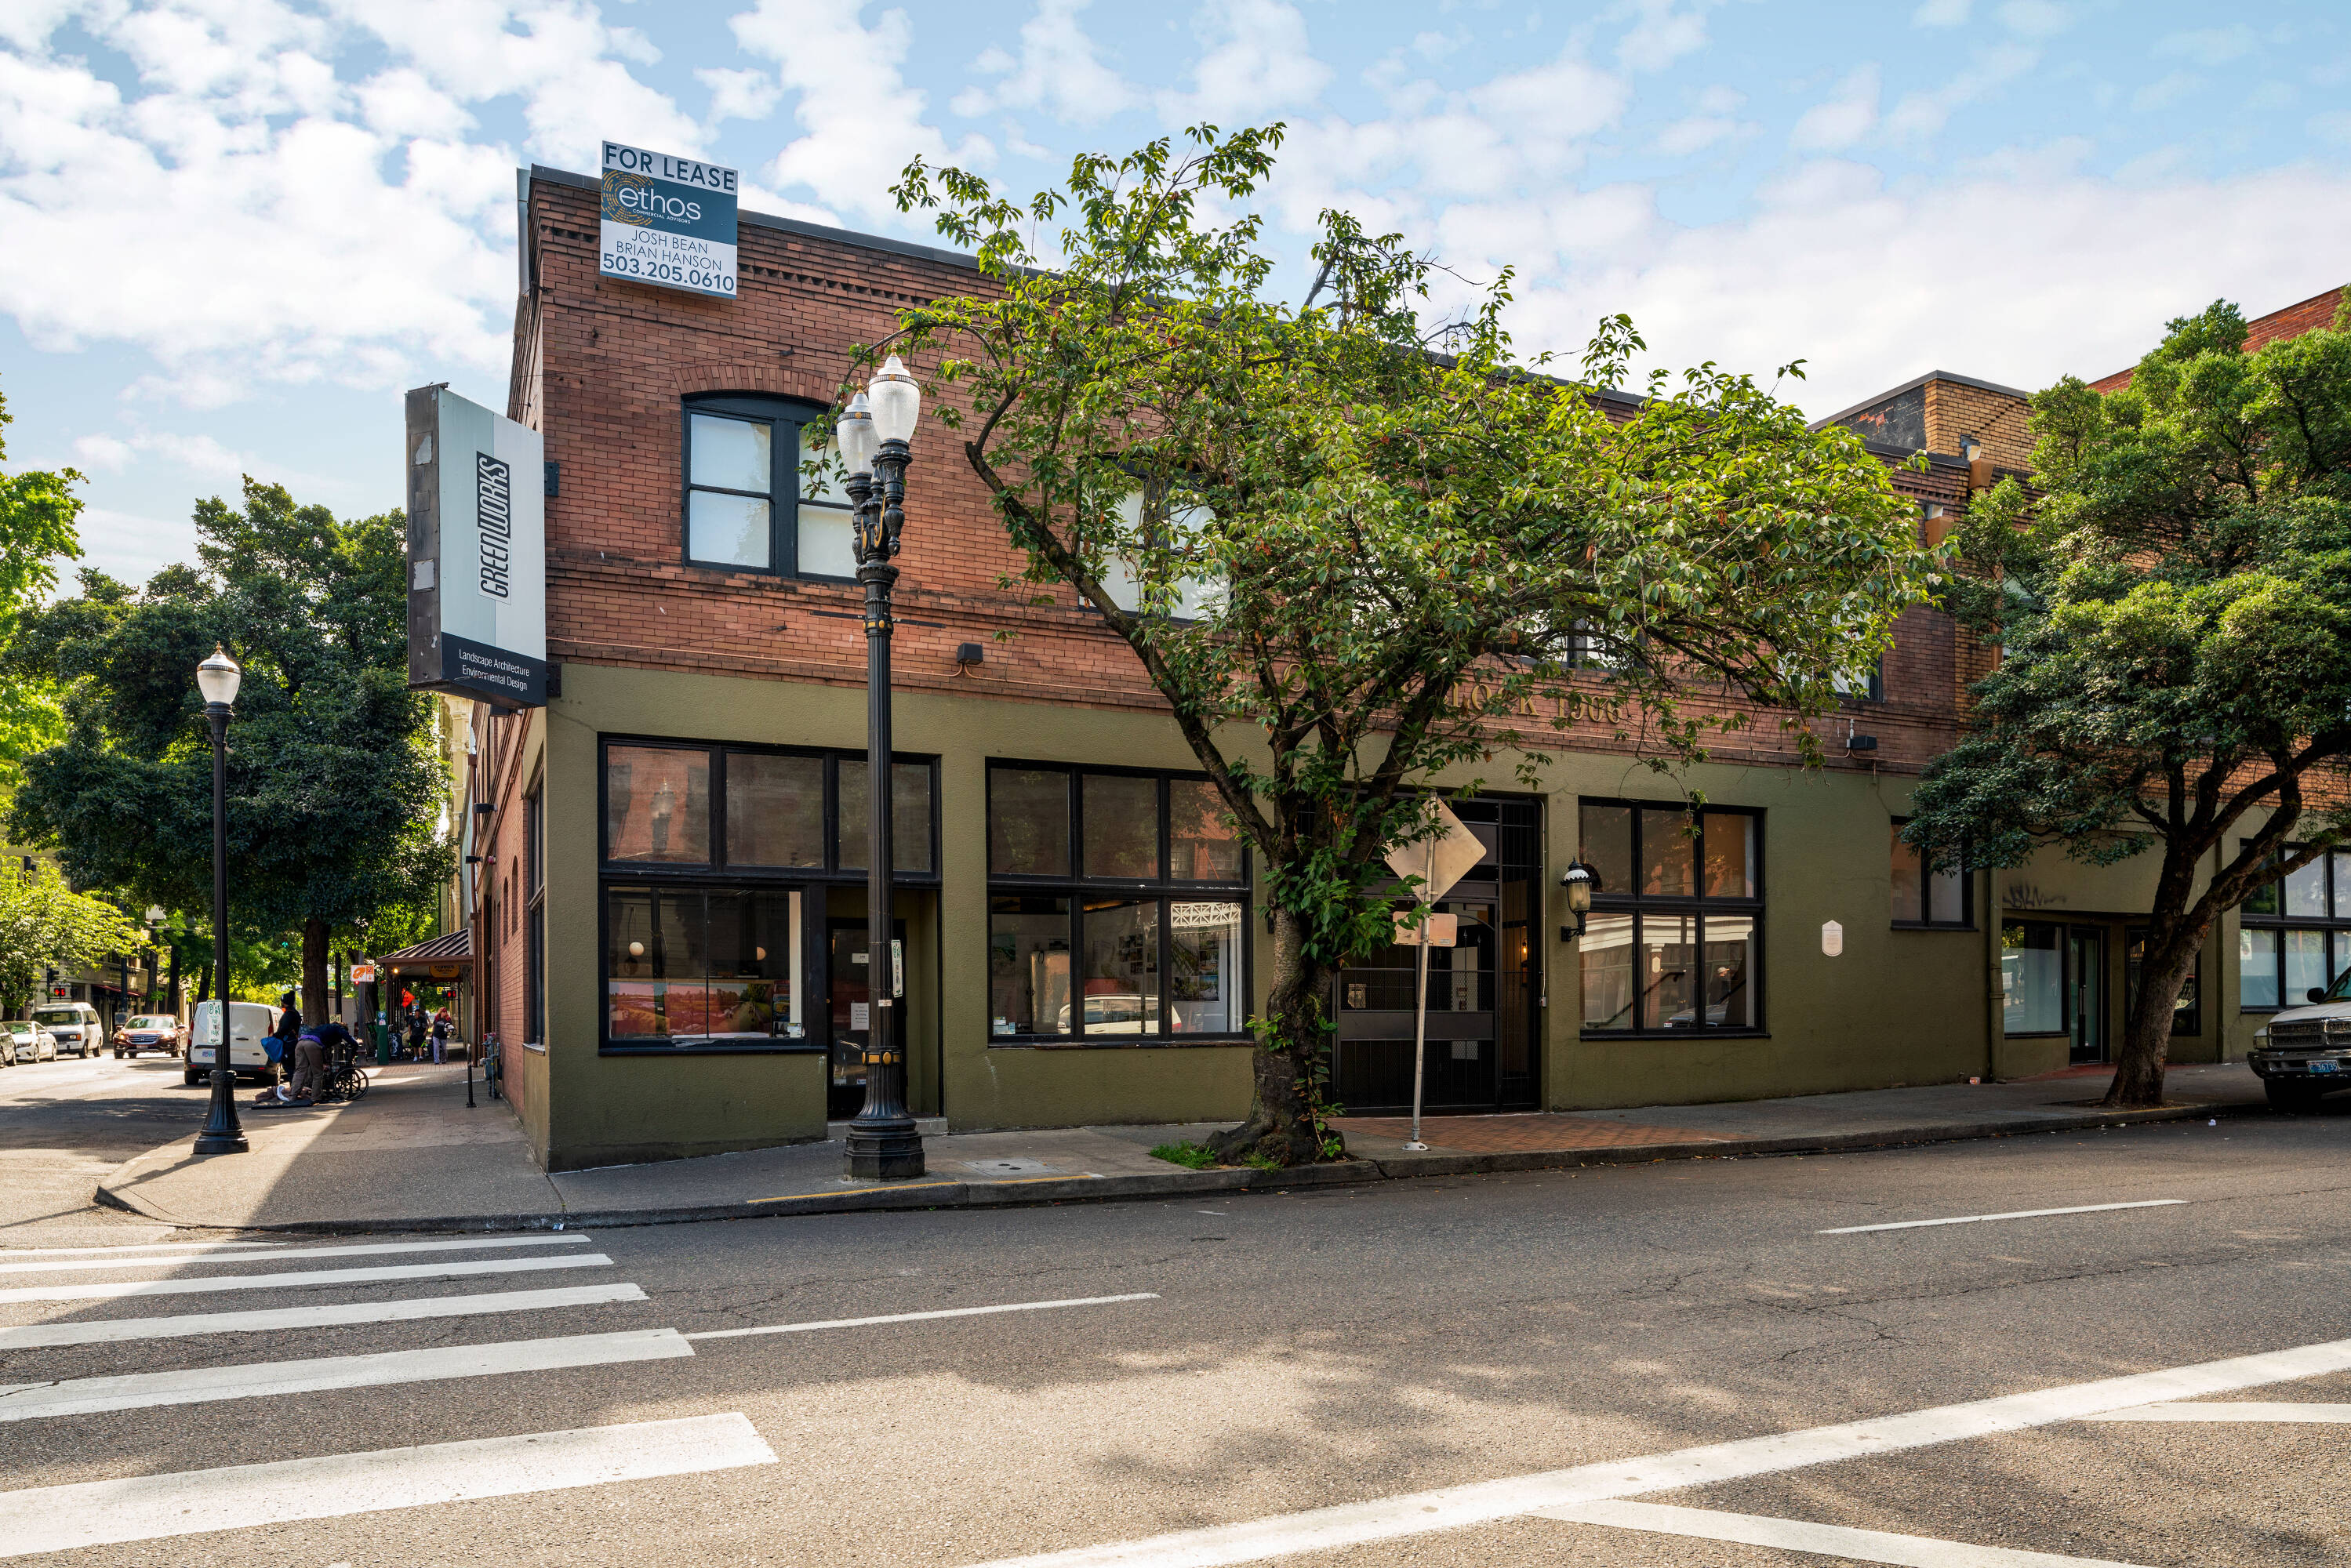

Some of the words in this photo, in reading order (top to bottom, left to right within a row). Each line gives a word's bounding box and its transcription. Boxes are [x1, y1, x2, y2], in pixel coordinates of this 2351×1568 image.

[605, 144, 652, 174] FOR
[663, 157, 735, 191] LEASE
[619, 187, 701, 220] ethos
[632, 209, 665, 220] COMMERCIAL
[667, 216, 691, 224] ADVISORS
[616, 241, 657, 260] BRIAN
[662, 250, 721, 271] HANSON
[631, 230, 667, 247] JOSH
[672, 238, 707, 254] BEAN
[603, 252, 735, 292] 503.205.0610
[478, 456, 509, 599] GREENWORKS
[459, 648, 492, 668] Landscape
[493, 658, 529, 677] Architecture
[507, 677, 528, 691] Design
